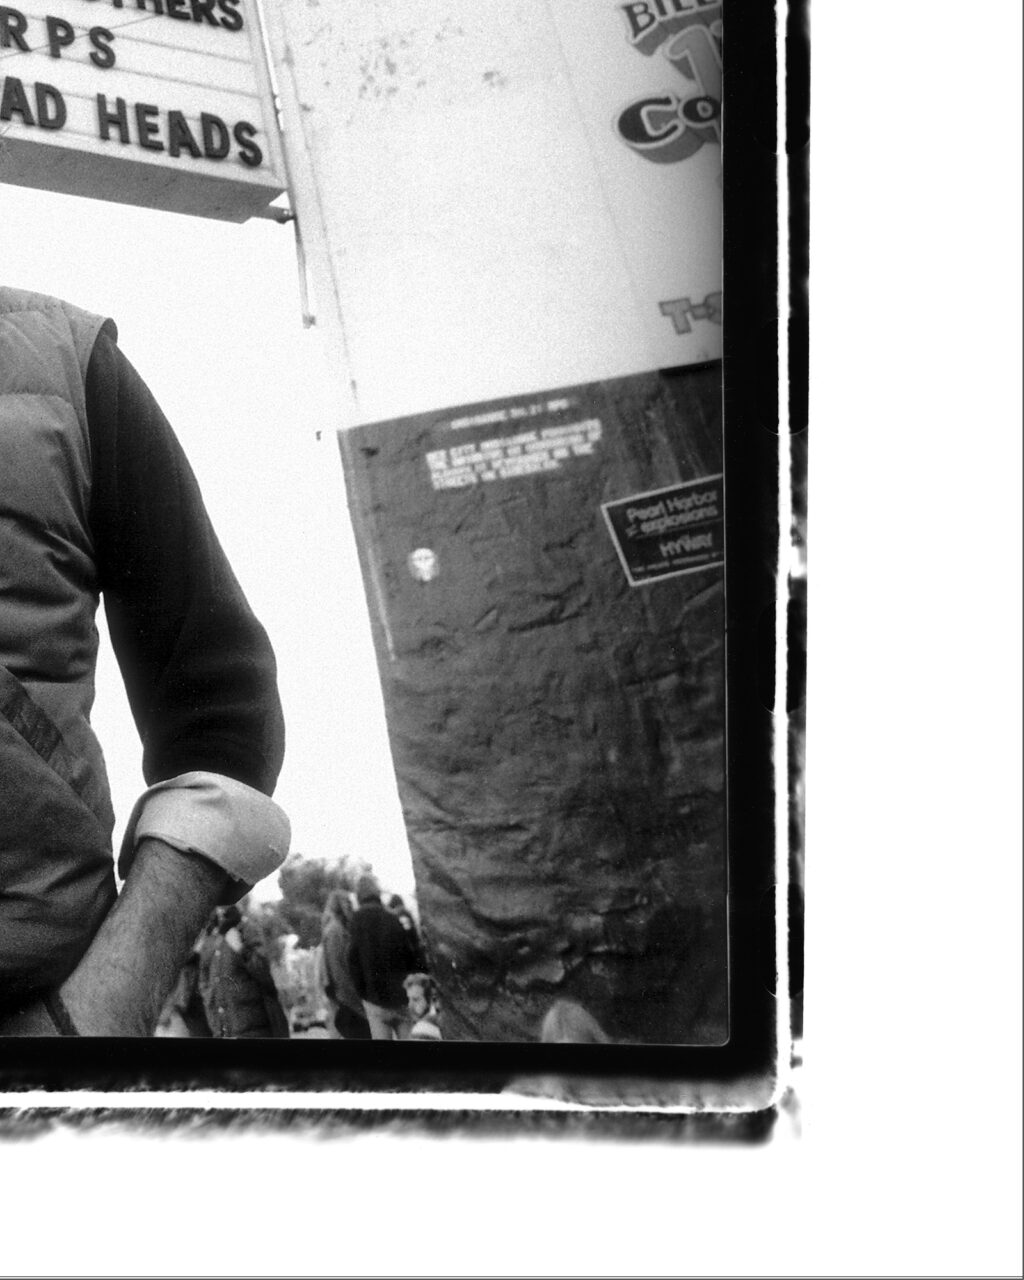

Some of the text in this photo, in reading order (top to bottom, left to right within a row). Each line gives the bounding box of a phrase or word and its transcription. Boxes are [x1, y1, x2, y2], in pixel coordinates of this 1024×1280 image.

[0, 75, 264, 167] AD HEADS
[626, 490, 718, 522] Pearl Harbor
